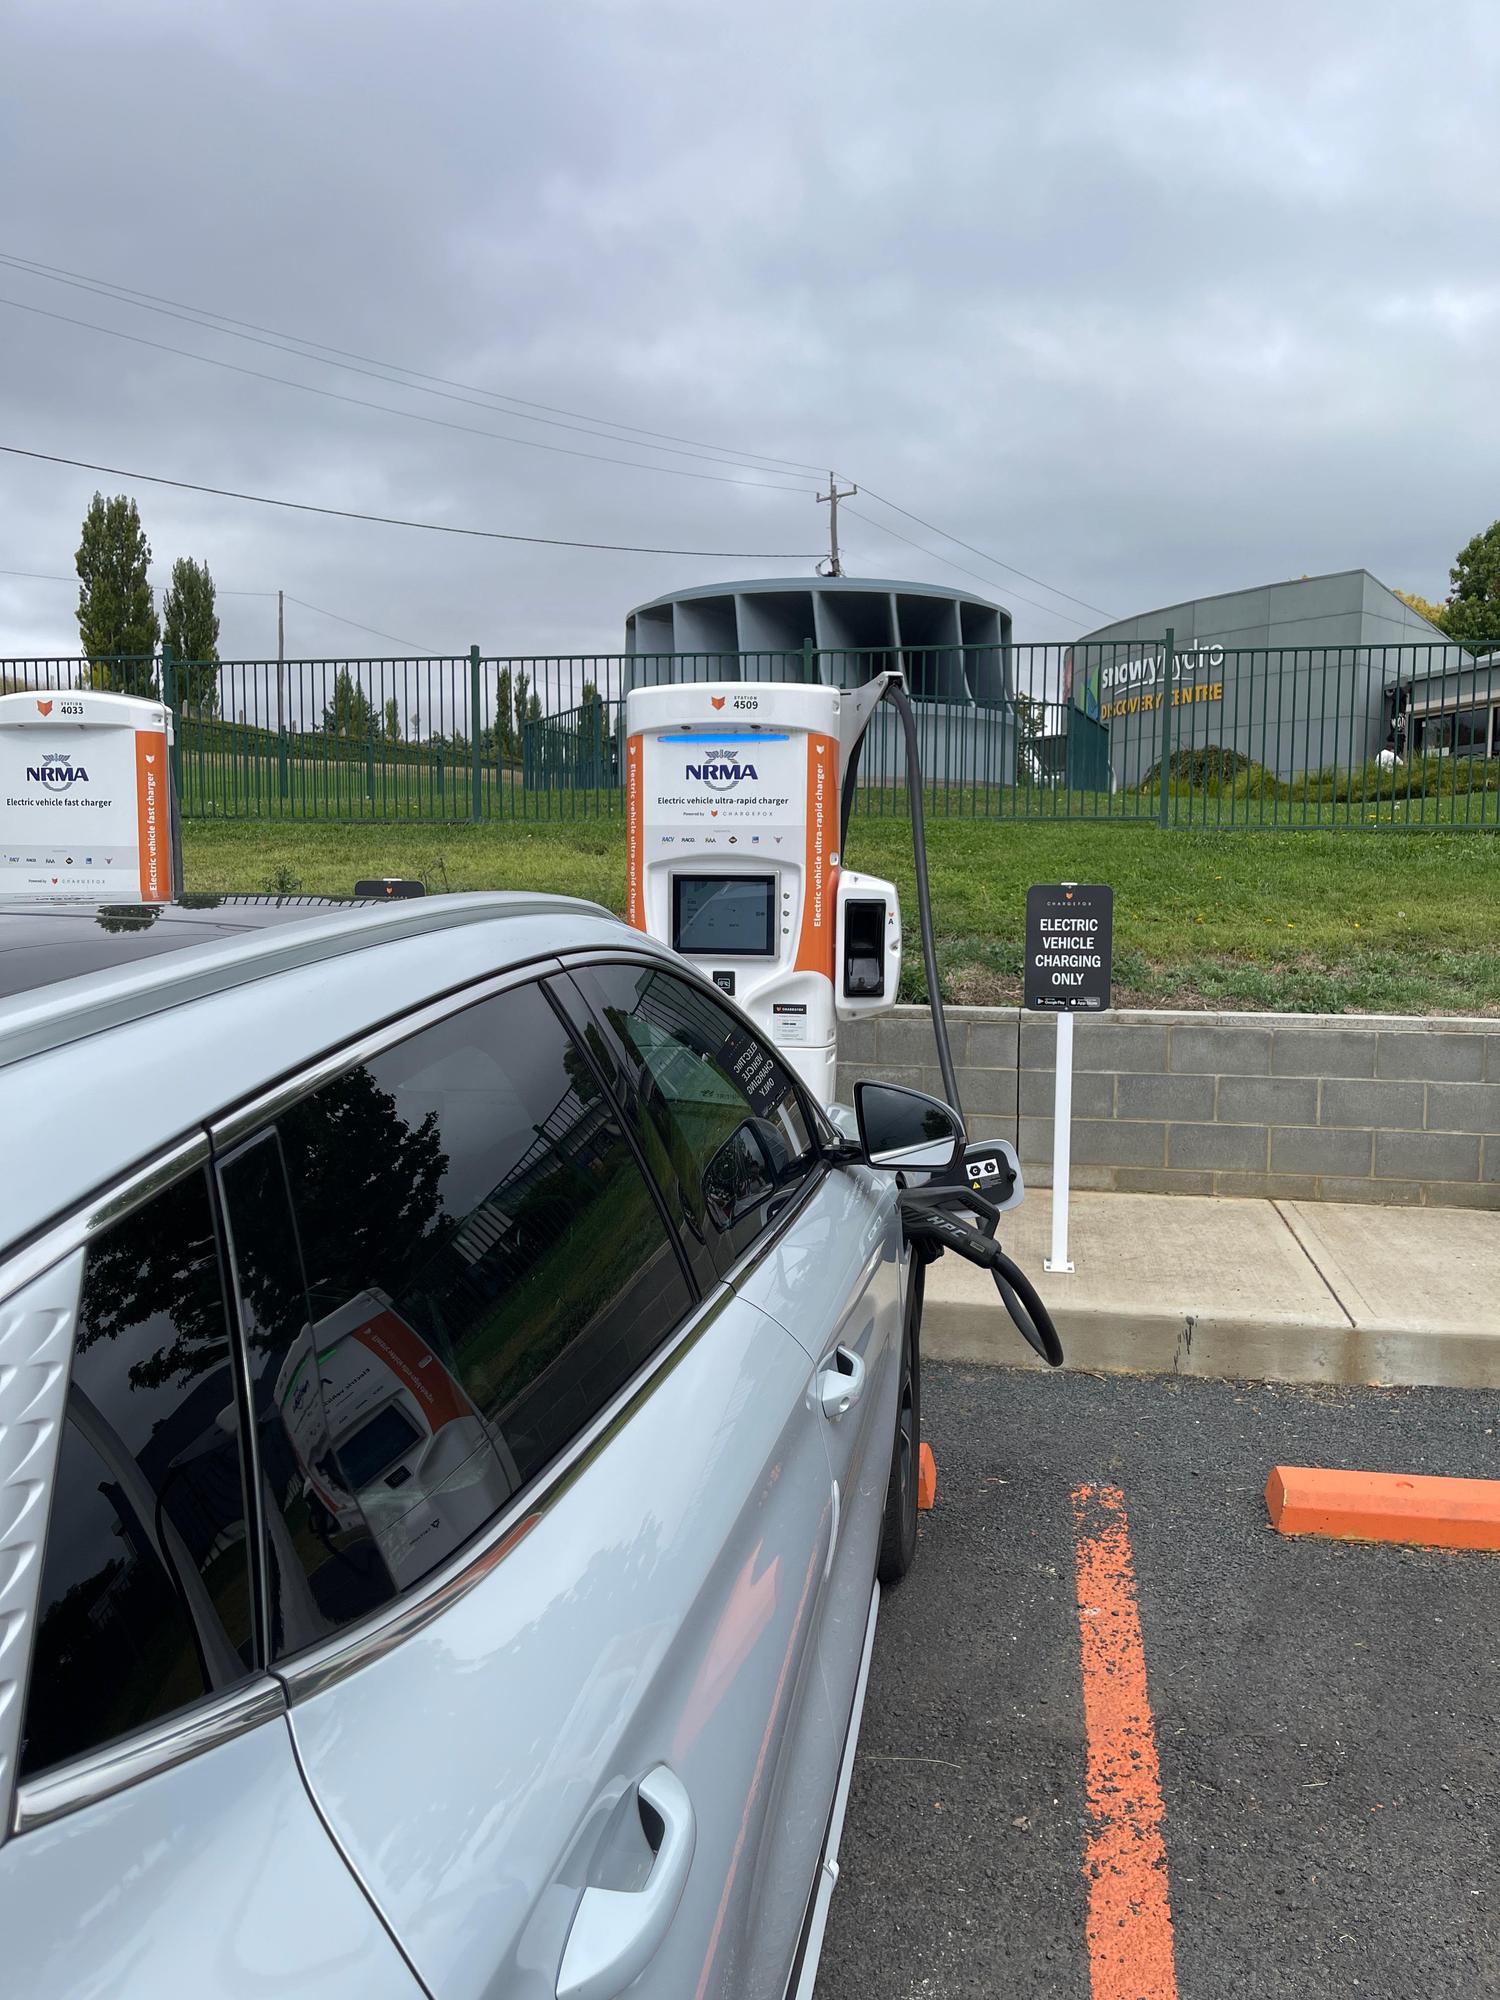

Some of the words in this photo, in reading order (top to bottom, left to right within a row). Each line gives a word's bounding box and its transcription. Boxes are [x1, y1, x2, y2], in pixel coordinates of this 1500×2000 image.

[1102, 655, 1162, 689] snowy
[1171, 682, 1223, 707] ENTRE
[60, 706, 84, 715] 4033
[734, 700, 758, 710] 4509
[26, 767, 90, 782] NRMA
[686, 764, 758, 780] NRMA
[146, 772, 156, 804] charger
[816, 764, 824, 800] charger
[6, 798, 34, 807] Electric
[36, 798, 63, 807] vehicle
[64, 799, 80, 807] fast
[80, 799, 112, 808] charger
[658, 796, 685, 805] Electric
[686, 796, 714, 805] vehicle
[716, 796, 756, 806] ultra-rapid
[758, 797, 789, 806] charger
[147, 807, 155, 824] fast
[814, 802, 824, 854] ultra-rapid
[148, 826, 156, 857] vehicle
[148, 858, 158, 891] Electric
[814, 891, 822, 927] Electric
[1040, 918, 1098, 932] ELECTRIC
[1042, 936, 1094, 950] VEHICLE
[1035, 954, 1101, 968] CHARGING
[1052, 972, 1084, 985] ONLY
[927, 1216, 968, 1237] HPC
